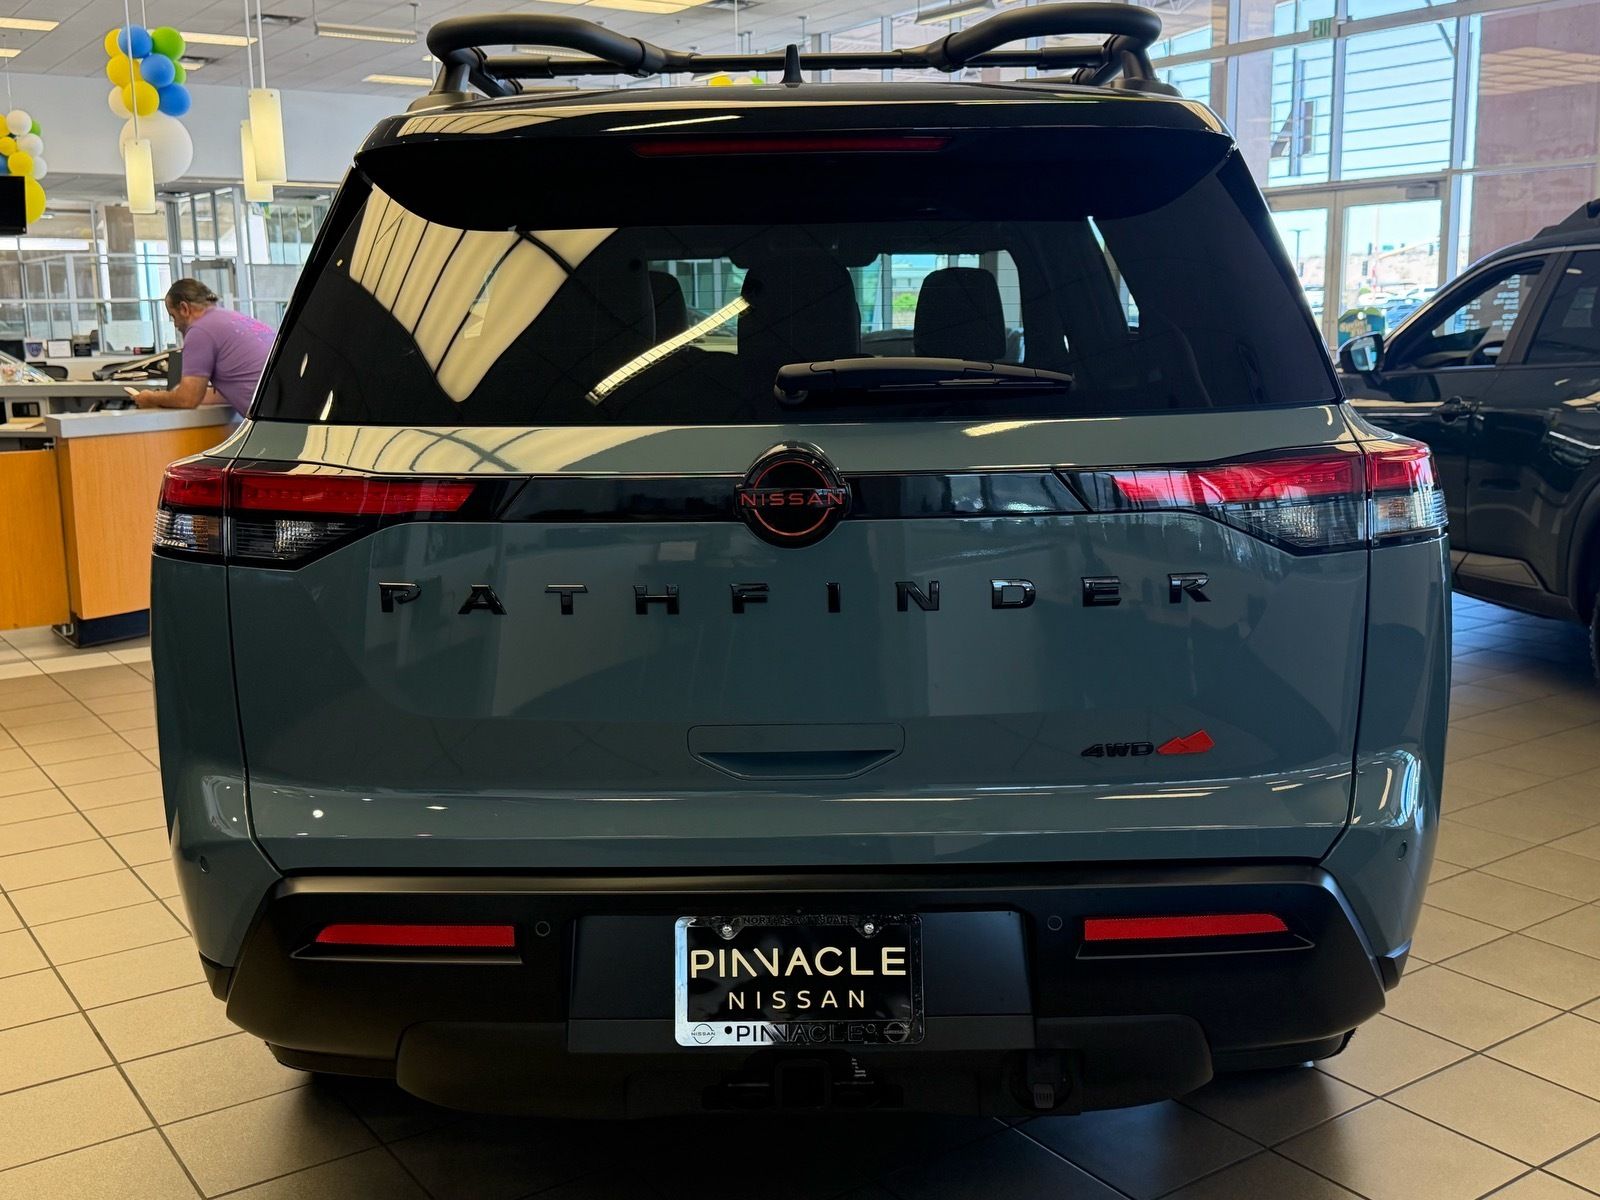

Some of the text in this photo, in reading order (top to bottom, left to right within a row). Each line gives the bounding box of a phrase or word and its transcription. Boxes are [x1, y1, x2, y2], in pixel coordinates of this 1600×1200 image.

[1312, 19, 1331, 38] EXIT
[740, 492, 843, 506] NISSAN
[379, 572, 1212, 615] PATHFINDER
[1081, 742, 1154, 757] 4WD
[690, 946, 907, 979] PINNACLE
[728, 990, 865, 1010] NISSAN
[736, 1023, 865, 1042] PINNACLE
